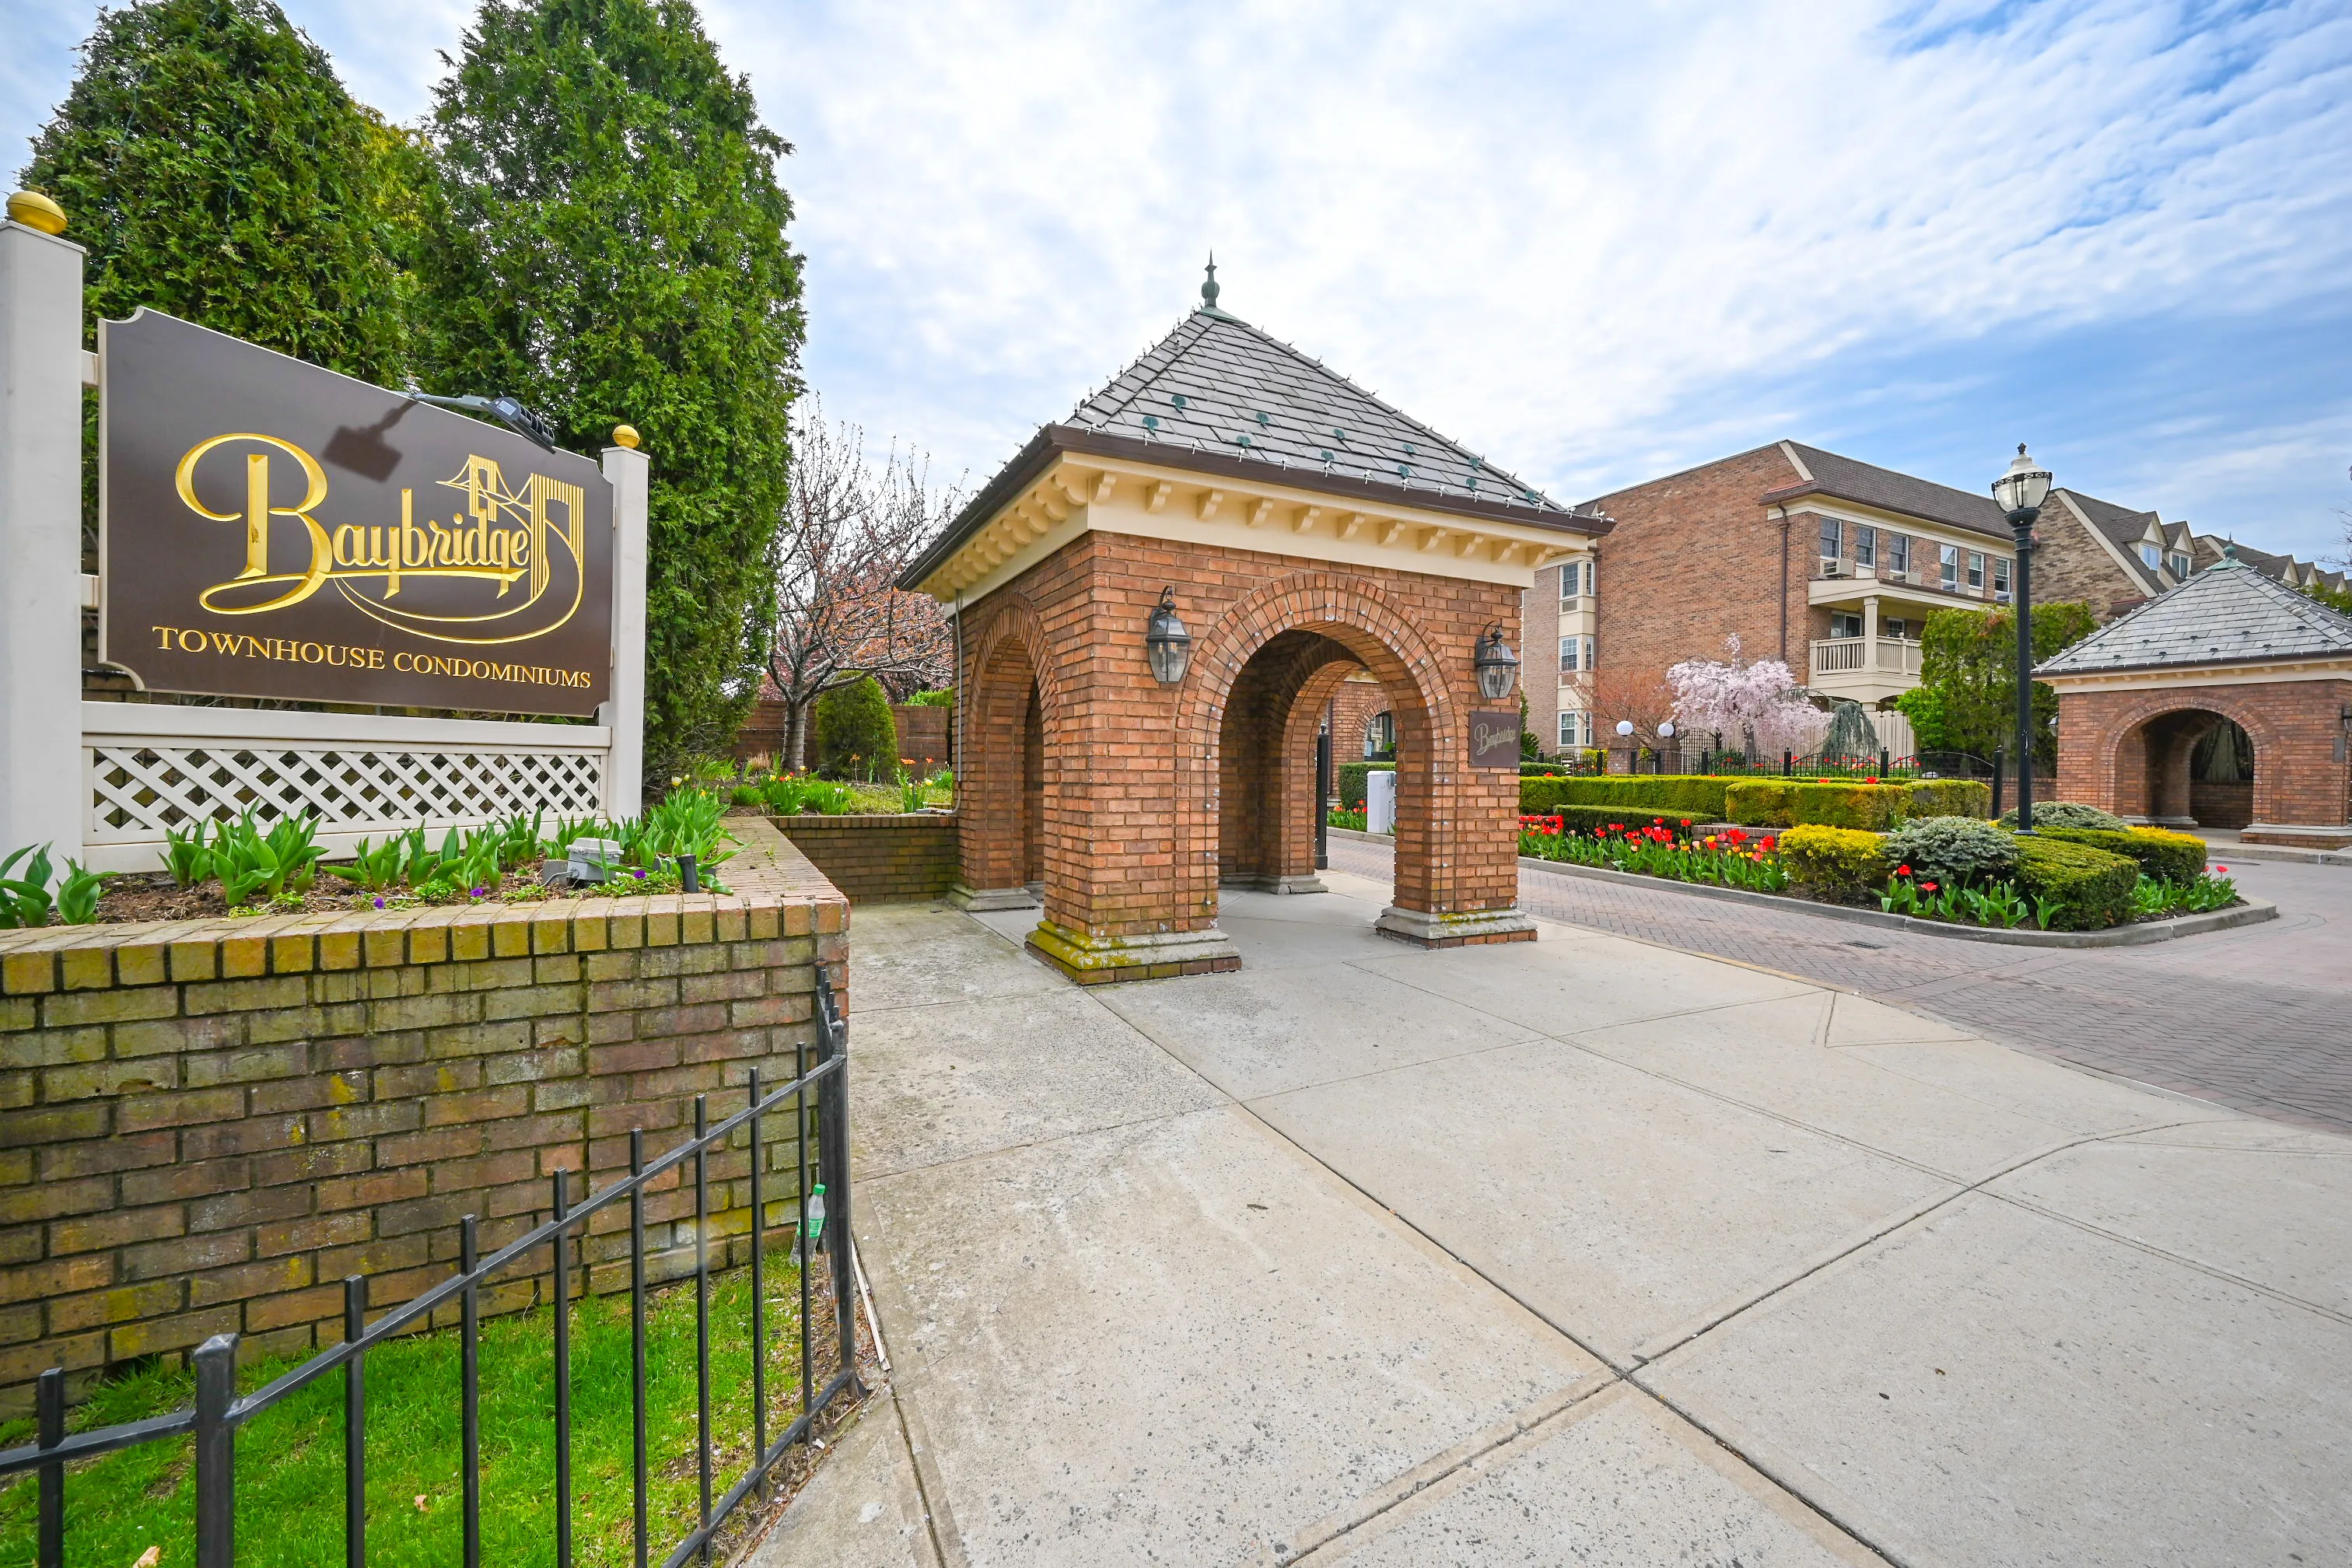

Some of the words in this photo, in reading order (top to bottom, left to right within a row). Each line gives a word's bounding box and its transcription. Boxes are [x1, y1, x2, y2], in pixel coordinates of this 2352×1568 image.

[175, 432, 530, 615] Baybridge
[152, 625, 385, 670] TOWNHOUSE
[394, 652, 591, 688] CONDOMINIUMS
[1474, 723, 1516, 756] Baybridge
